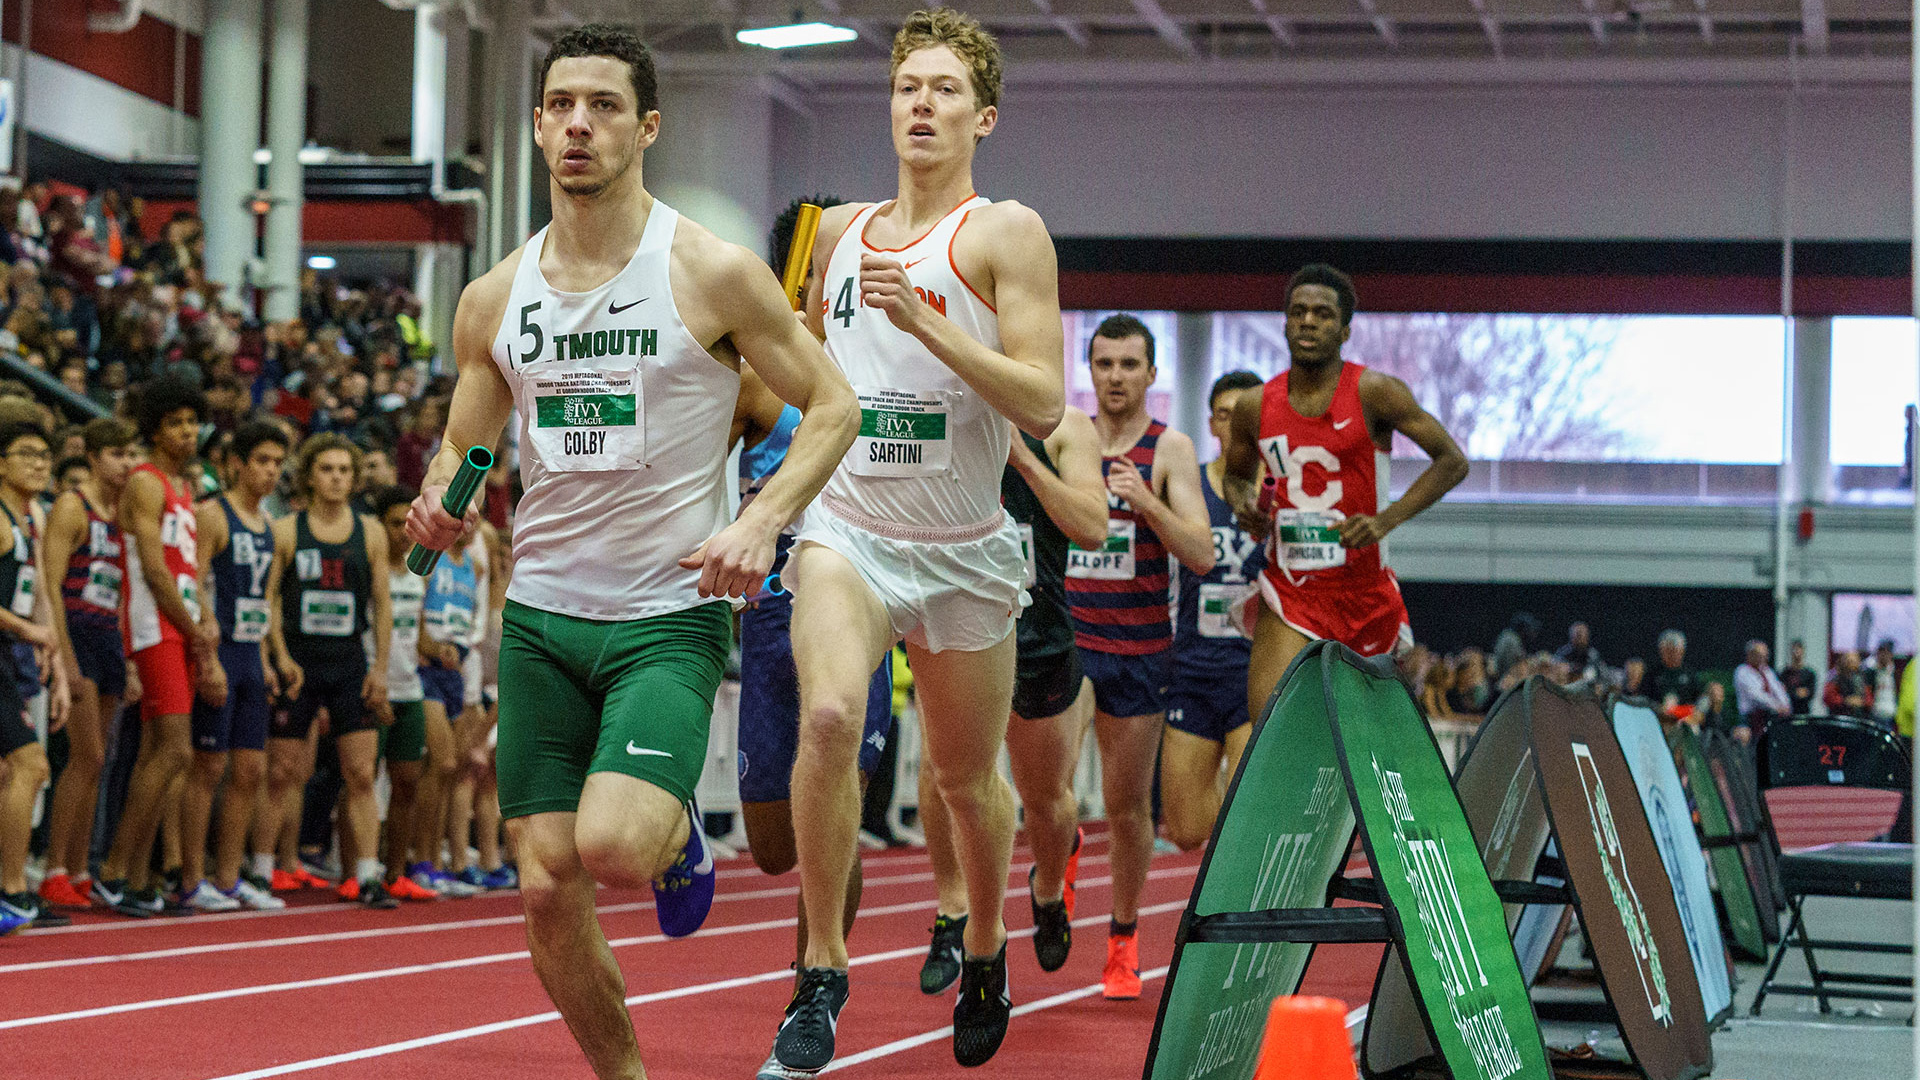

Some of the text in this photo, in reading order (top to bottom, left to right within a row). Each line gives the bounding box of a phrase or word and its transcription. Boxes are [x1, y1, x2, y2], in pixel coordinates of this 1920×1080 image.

[833, 276, 855, 328] 4
[519, 301, 544, 364] 5
[546, 329, 658, 362] TMOUTH
[574, 402, 602, 418] IVY
[574, 417, 604, 426] LEAGUE
[886, 418, 916, 432] IVY
[564, 431, 607, 456] COLBY
[869, 441, 922, 464] SARTINI
[1269, 441, 1286, 475] 1
[1287, 445, 1343, 511] C
[1071, 554, 1123, 569] KLOPF
[1818, 744, 1847, 766] 27
[1386, 770, 1415, 822] THE
[1407, 838, 1489, 997] IVY
[1466, 1005, 1522, 1080] LEAGUE
